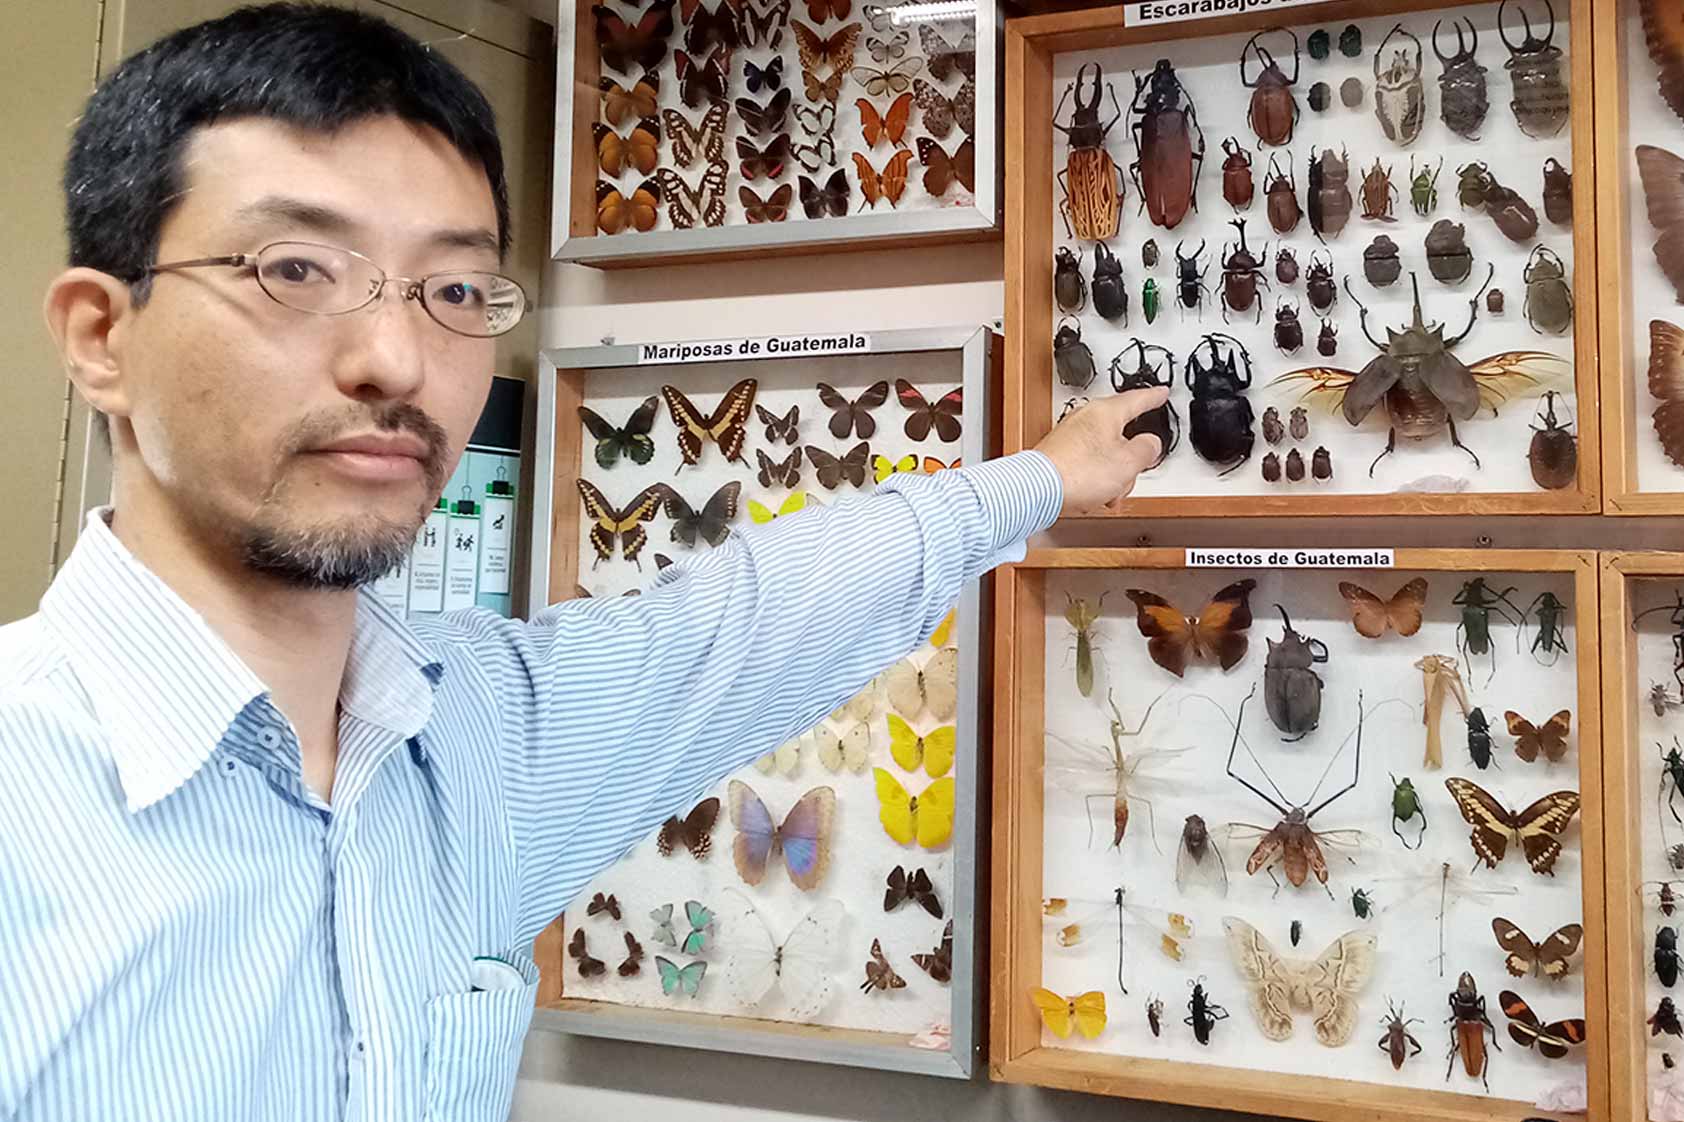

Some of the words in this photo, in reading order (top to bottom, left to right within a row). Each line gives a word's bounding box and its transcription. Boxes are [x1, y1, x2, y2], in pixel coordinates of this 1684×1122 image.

[643, 343, 733, 360] Mariposas
[738, 340, 761, 354] de
[766, 333, 866, 353] Guatemala
[1191, 552, 1263, 565] Insectos
[1268, 552, 1289, 565] de
[1294, 552, 1391, 565] Guatemala
